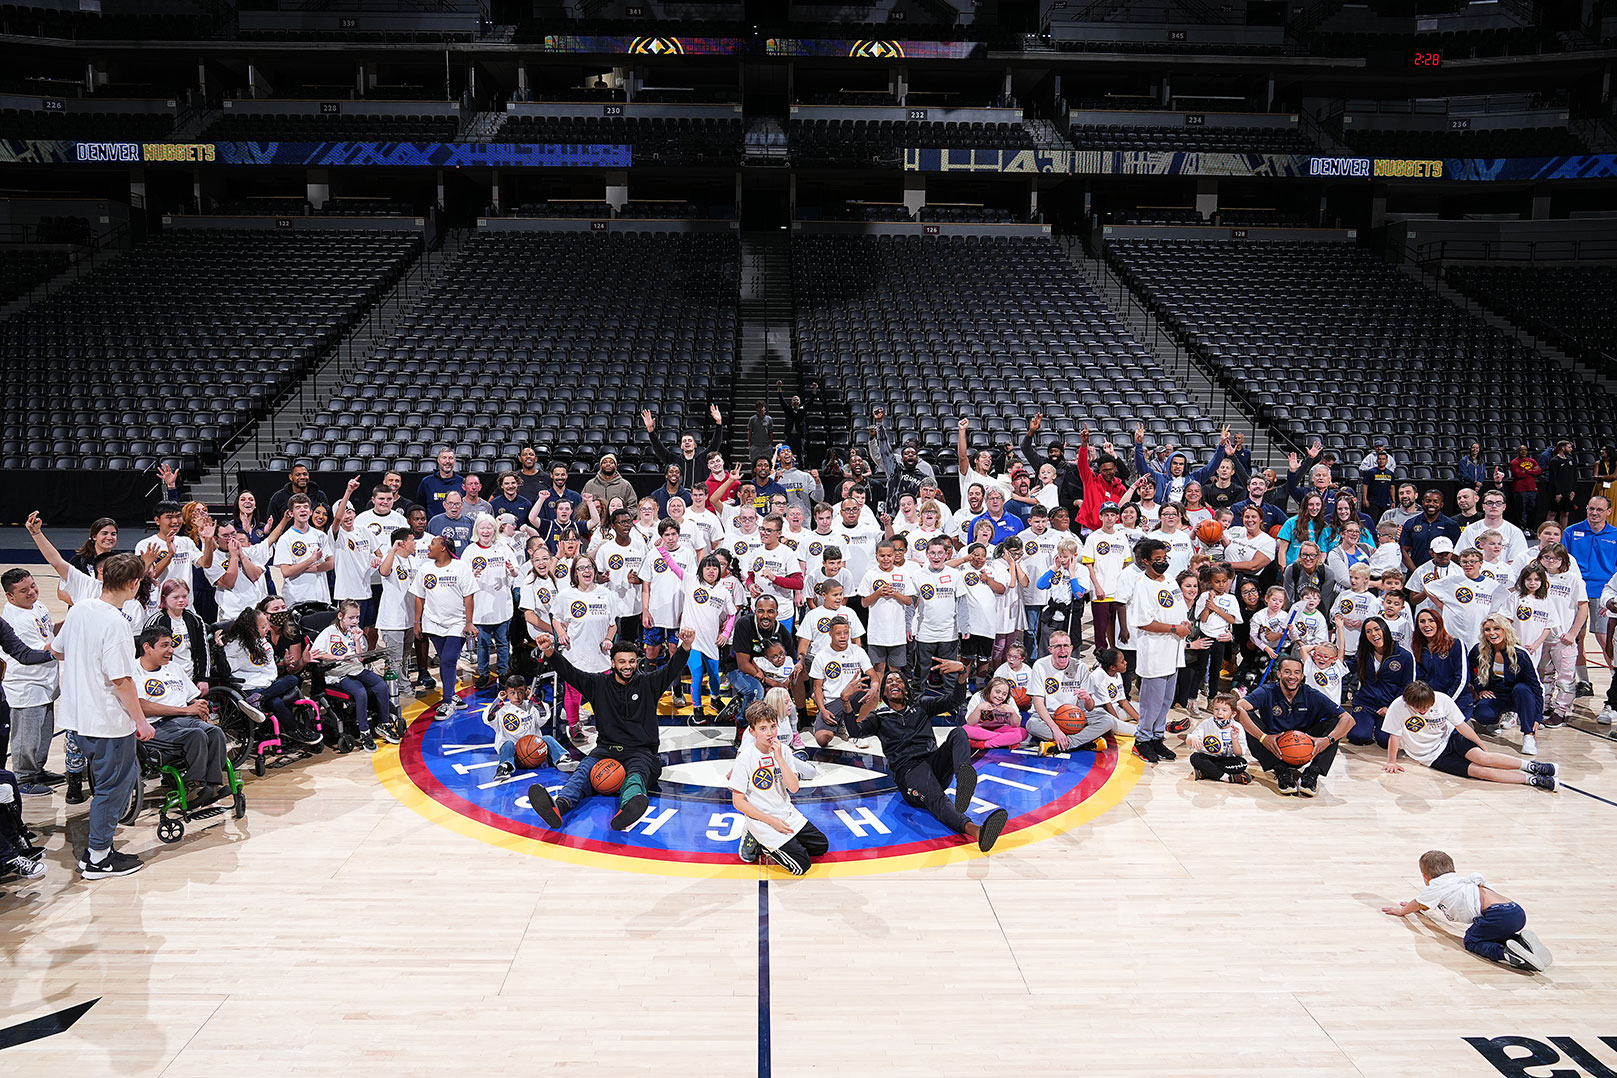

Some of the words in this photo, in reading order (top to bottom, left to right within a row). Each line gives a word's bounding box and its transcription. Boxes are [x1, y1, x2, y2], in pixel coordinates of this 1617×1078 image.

[629, 8, 641, 16] 341
[343, 20, 355, 28] 339
[1171, 32, 1184, 40] 345
[1414, 52, 1440, 66] 2:28
[46, 102, 61, 110] 226
[323, 104, 337, 112] 228
[607, 107, 620, 115] 230
[911, 111, 925, 119] 232
[1452, 121, 1468, 129] 236
[77, 143, 139, 161] DENVER
[142, 143, 216, 162] NUGGETS
[1310, 158, 1370, 177] DENVER
[1373, 159, 1443, 178] NUGGETS
